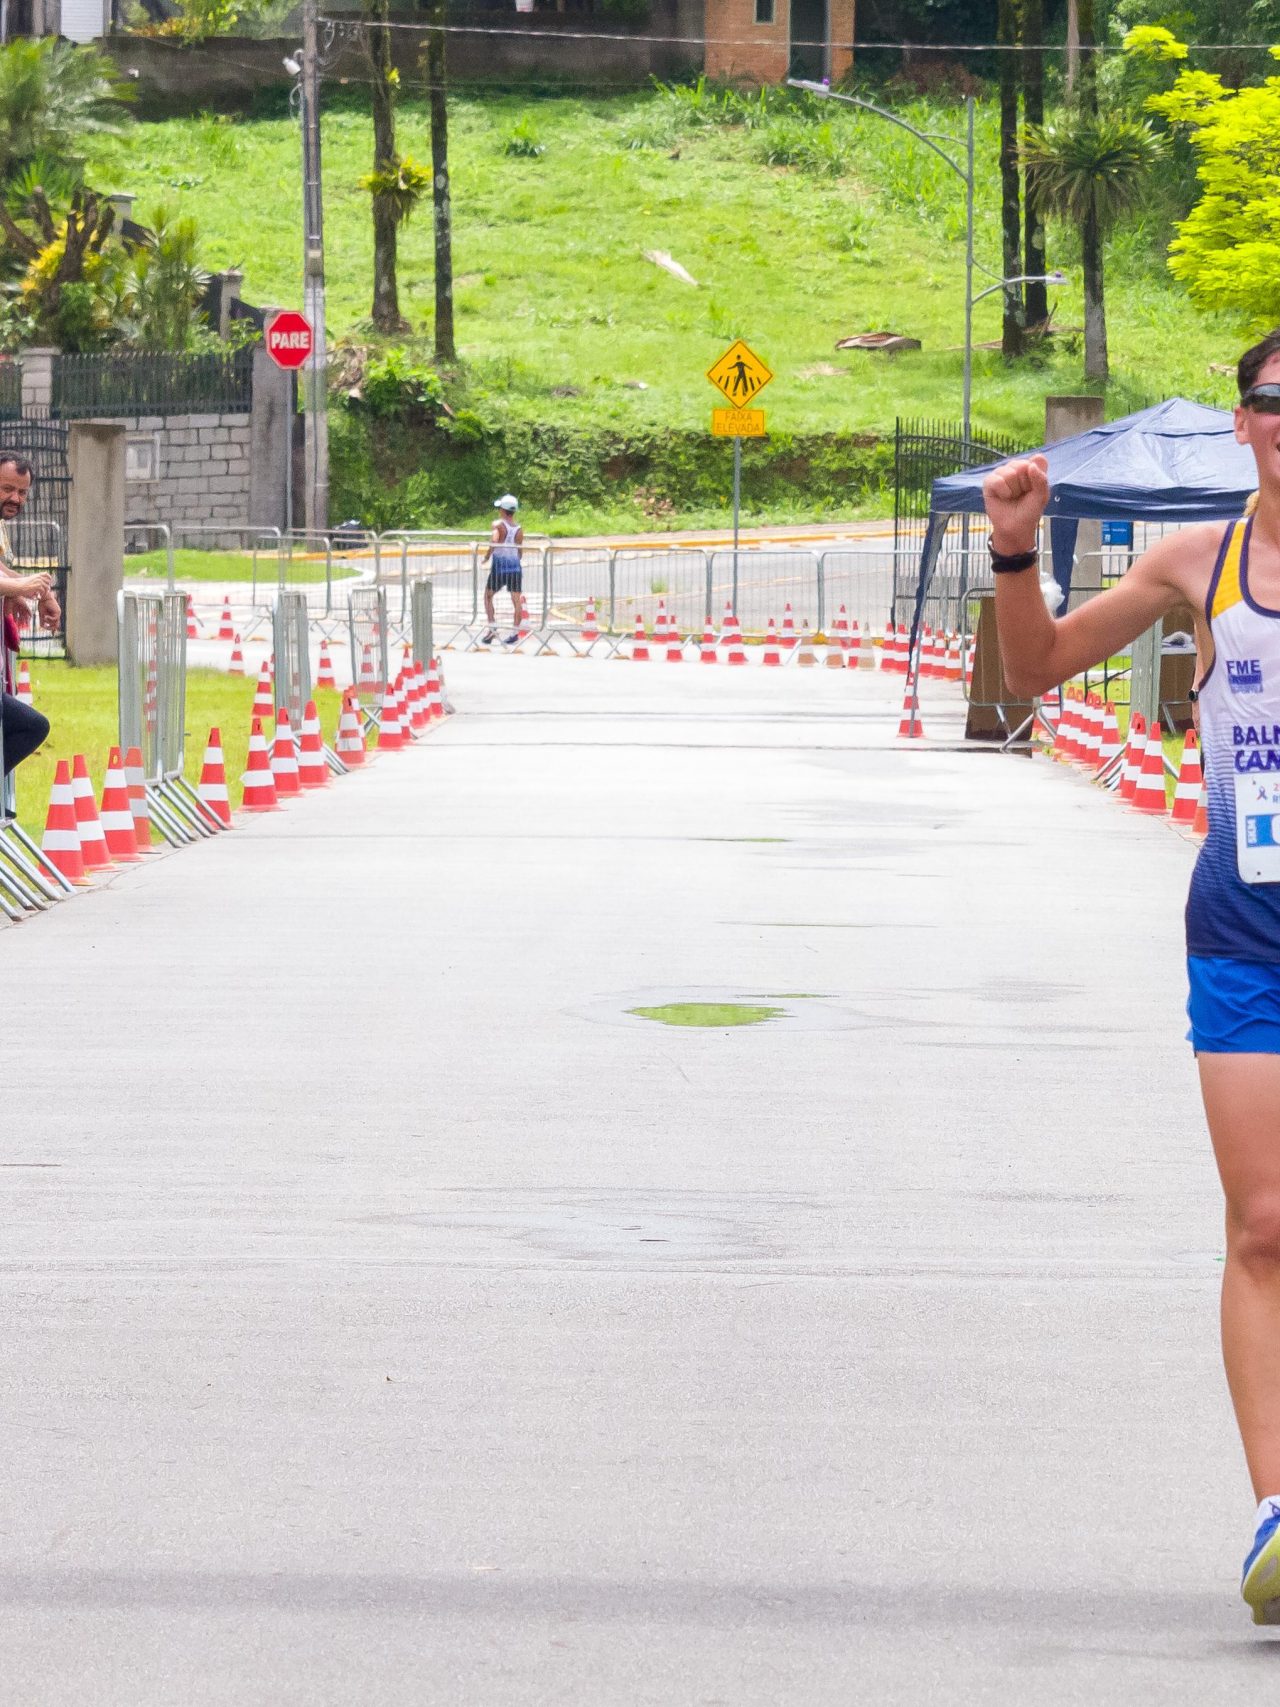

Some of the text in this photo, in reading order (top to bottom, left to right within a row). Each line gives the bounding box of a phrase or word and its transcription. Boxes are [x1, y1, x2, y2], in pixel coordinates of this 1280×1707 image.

[271, 331, 310, 350] PARE
[725, 412, 753, 421] FAIXA
[716, 423, 760, 433] ELEVADA
[1226, 660, 1262, 674] FME
